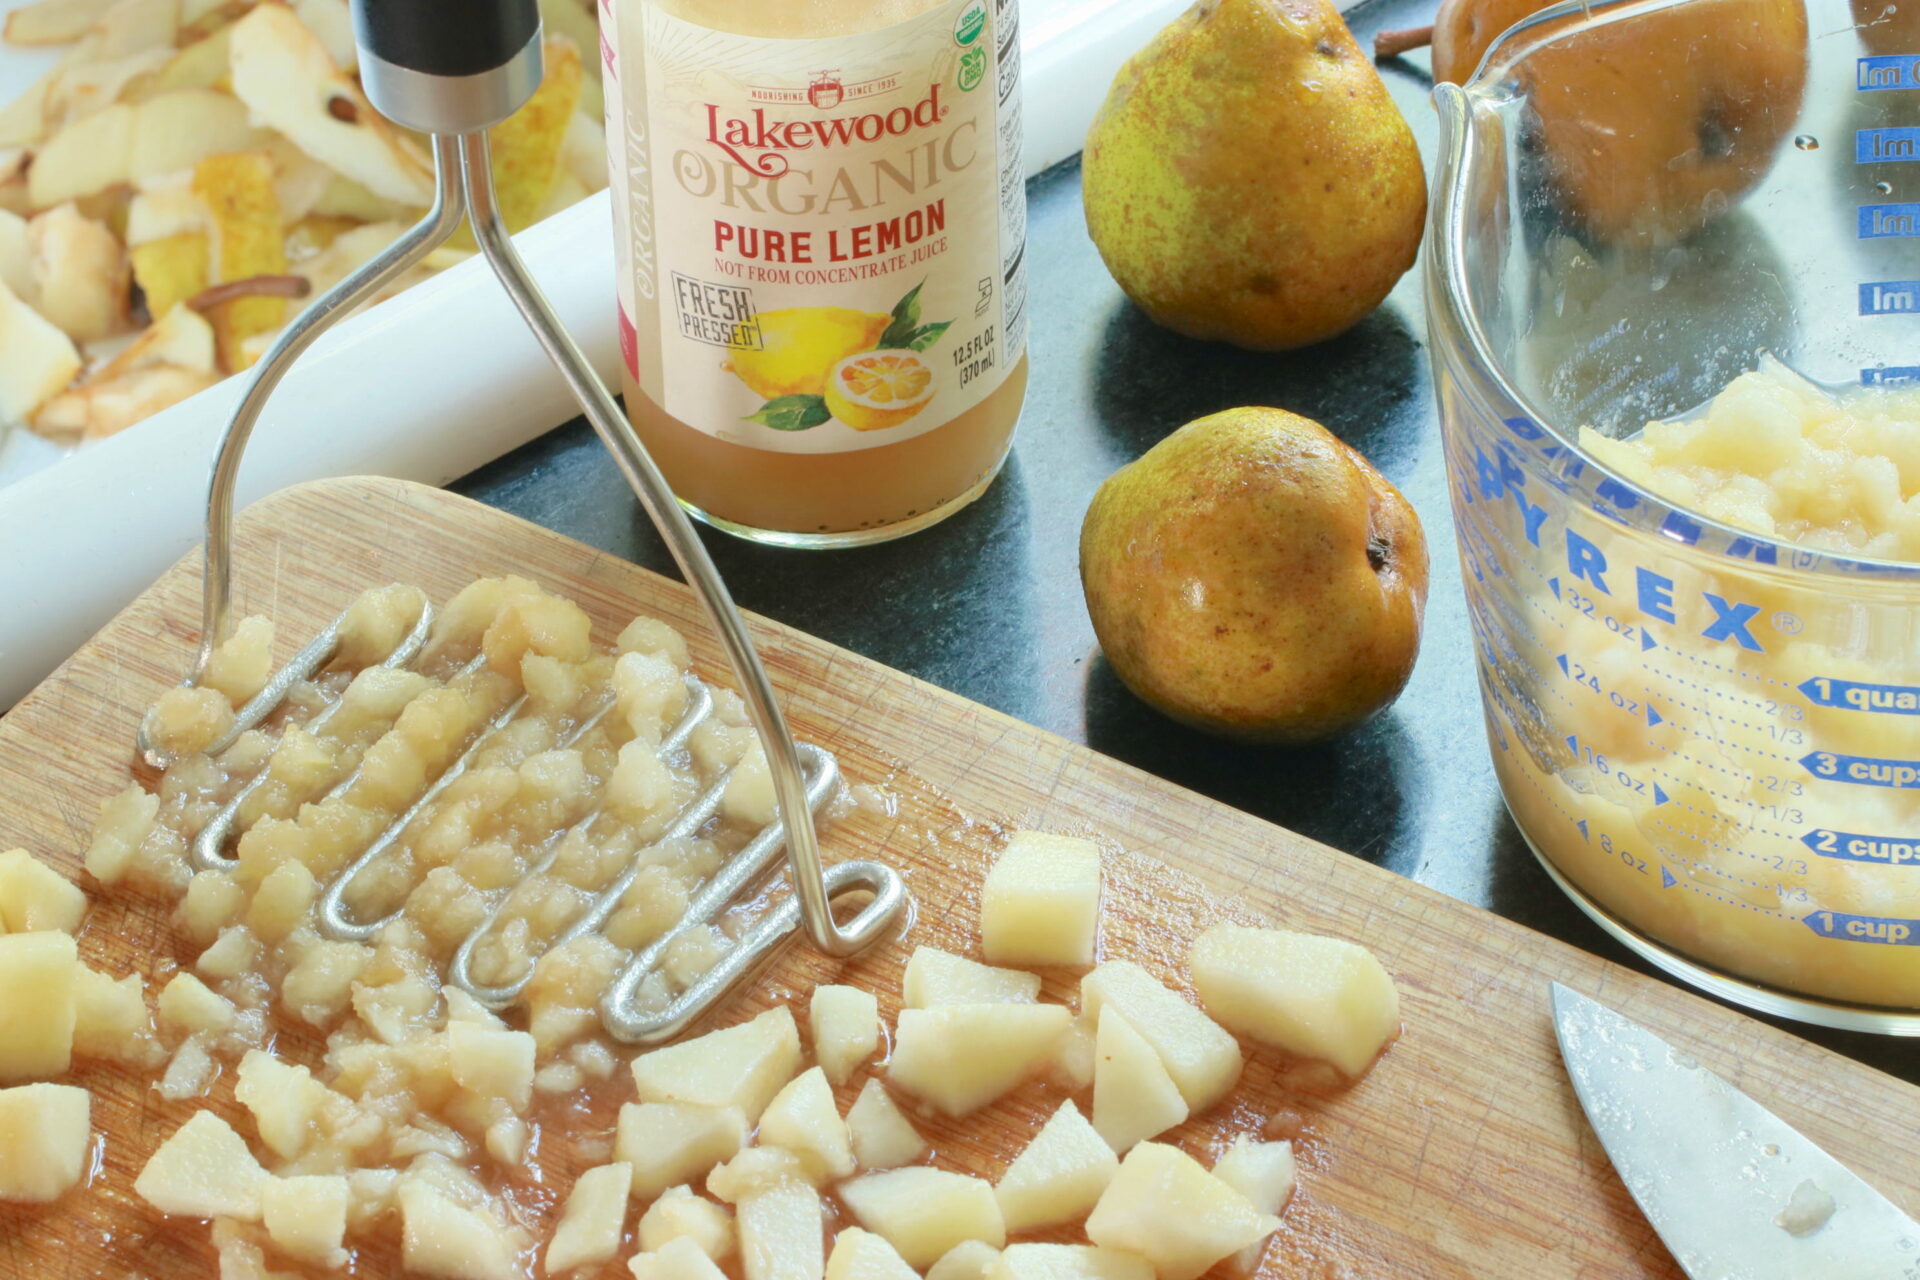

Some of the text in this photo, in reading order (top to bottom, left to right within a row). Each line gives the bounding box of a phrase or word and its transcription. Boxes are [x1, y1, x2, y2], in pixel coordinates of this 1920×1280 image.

[961, 6, 980, 26] USDA
[965, 61, 981, 78] NON
[751, 89, 803, 102] NOURISHING
[848, 78, 897, 97] SINCE 1935
[672, 115, 979, 216] ORGANIC
[625, 109, 656, 300] ORGANIC
[713, 219, 813, 264] PURE
[828, 198, 946, 263] LEMON
[714, 236, 949, 285] NOT FROM CONCENTRATE JUICE
[676, 277, 752, 322] FRESH
[682, 312, 753, 346] PRESSED
[953, 341, 972, 367] 12.5
[974, 335, 983, 354] FL
[985, 326, 994, 346] OZ
[960, 360, 980, 389] (370
[1567, 587, 1596, 621] 32
[1574, 663, 1602, 694] 24
[1814, 679, 1920, 711] 1 qua
[1764, 699, 1804, 721] 2/3
[1767, 724, 1803, 744] 1/3
[1584, 746, 1610, 775] 16
[1816, 753, 1838, 775] 3
[1765, 775, 1804, 797] 2/3
[1769, 804, 1804, 824] 1/3
[1600, 833, 1613, 855] 8
[1816, 830, 1838, 853] 2
[1772, 855, 1809, 875] 2/3
[1775, 882, 1809, 902] 1/3
[1818, 912, 1911, 944] 1 cup
